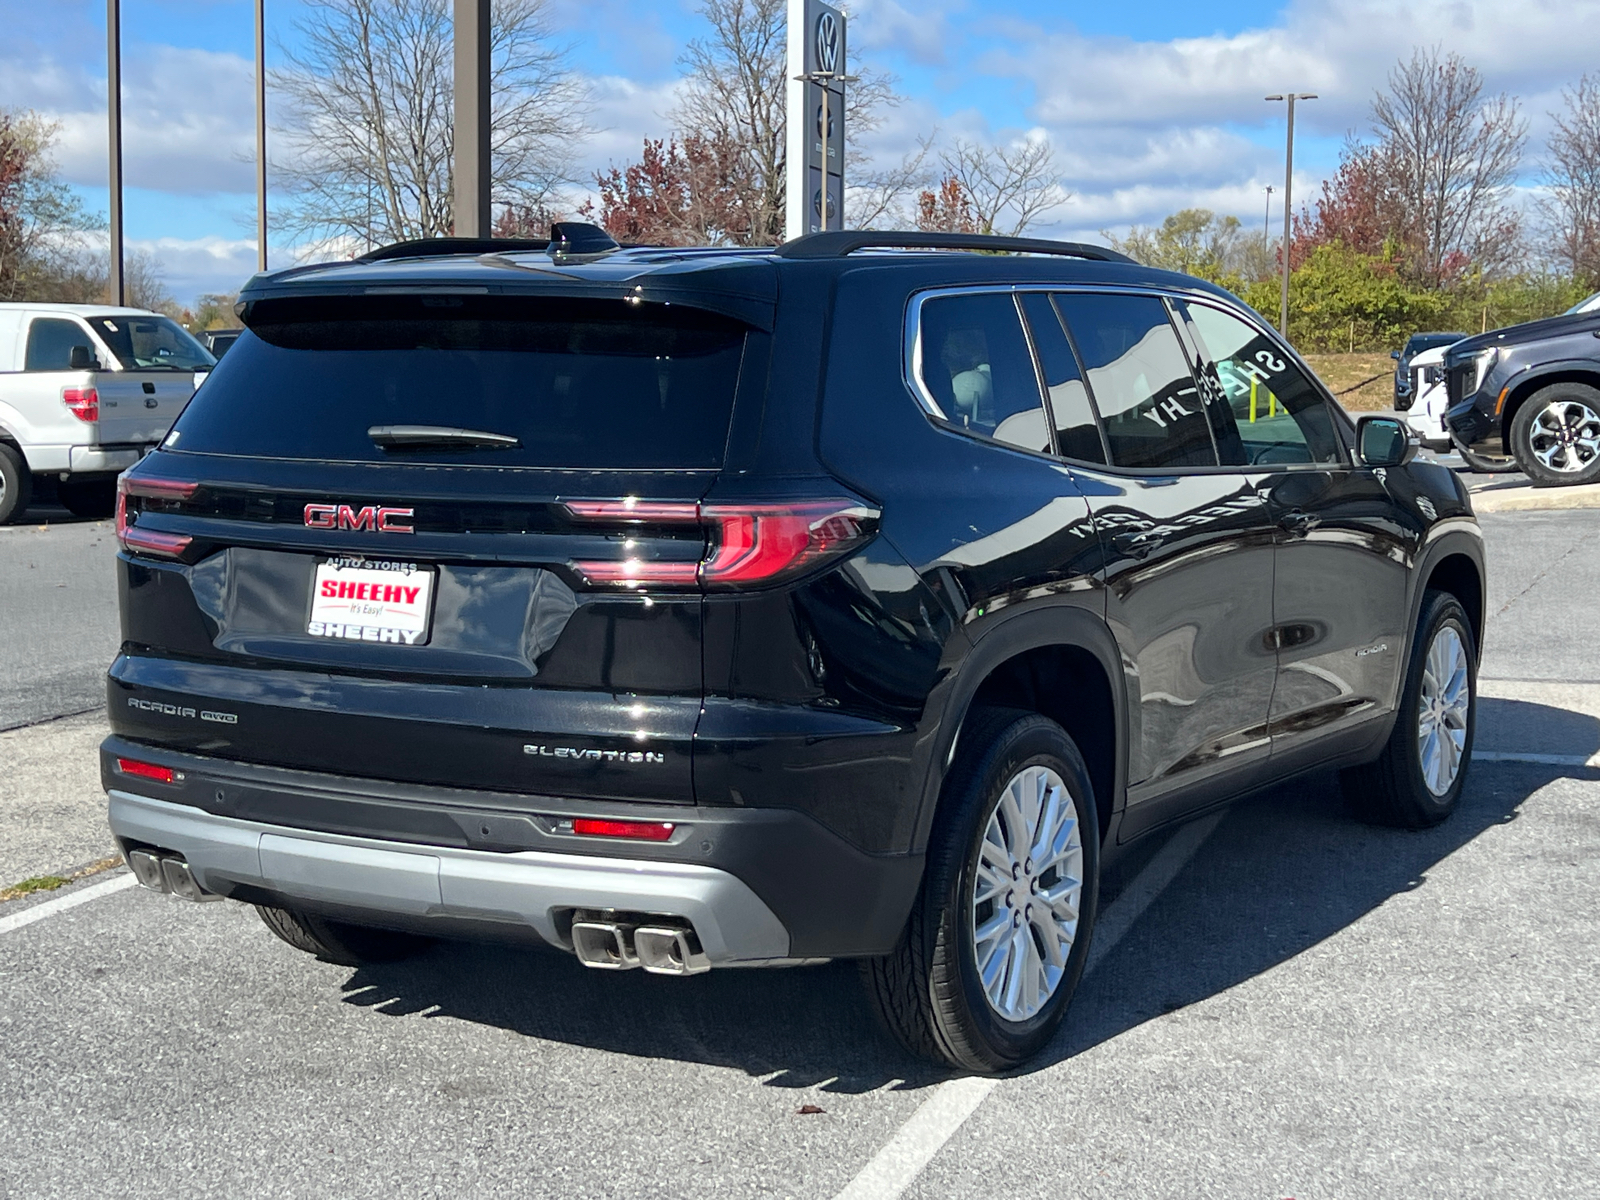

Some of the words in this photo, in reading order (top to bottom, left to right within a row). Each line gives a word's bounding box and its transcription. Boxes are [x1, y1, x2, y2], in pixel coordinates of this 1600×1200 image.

[304, 503, 415, 534] GMC
[326, 557, 361, 568] AUTO
[365, 560, 417, 572] STORES
[321, 580, 421, 604] SHEEHY
[350, 603, 361, 614] It's
[363, 604, 384, 617] Easy!
[308, 621, 422, 645] SHEEHY
[128, 698, 196, 718] ACADIA
[202, 711, 236, 723] AWD
[523, 744, 664, 763] ELEVATION
